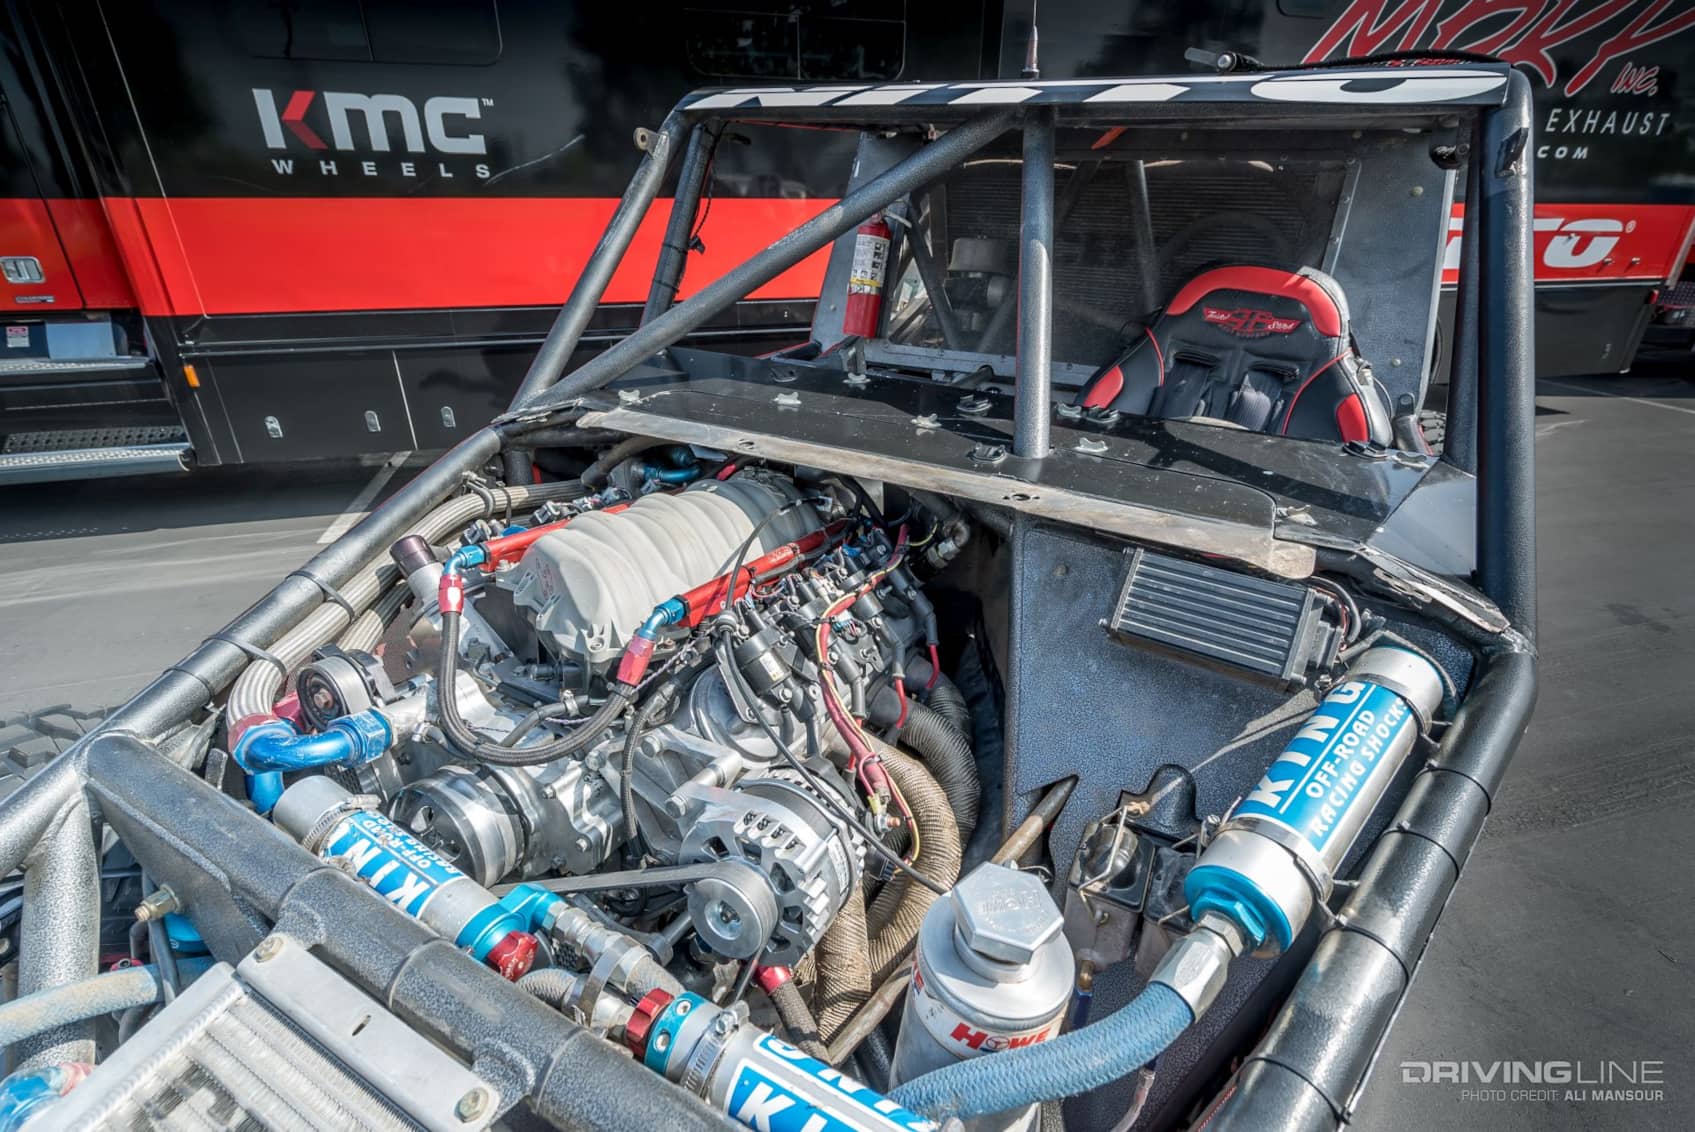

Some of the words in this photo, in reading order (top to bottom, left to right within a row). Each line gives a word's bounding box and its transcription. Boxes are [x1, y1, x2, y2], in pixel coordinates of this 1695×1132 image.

[1545, 108, 1670, 136] EXHAUST
[272, 159, 491, 178] WHEELS
[1250, 681, 1367, 809] KING
[1305, 709, 1376, 798] OFF-ROAD
[1309, 761, 1367, 837] RACING
